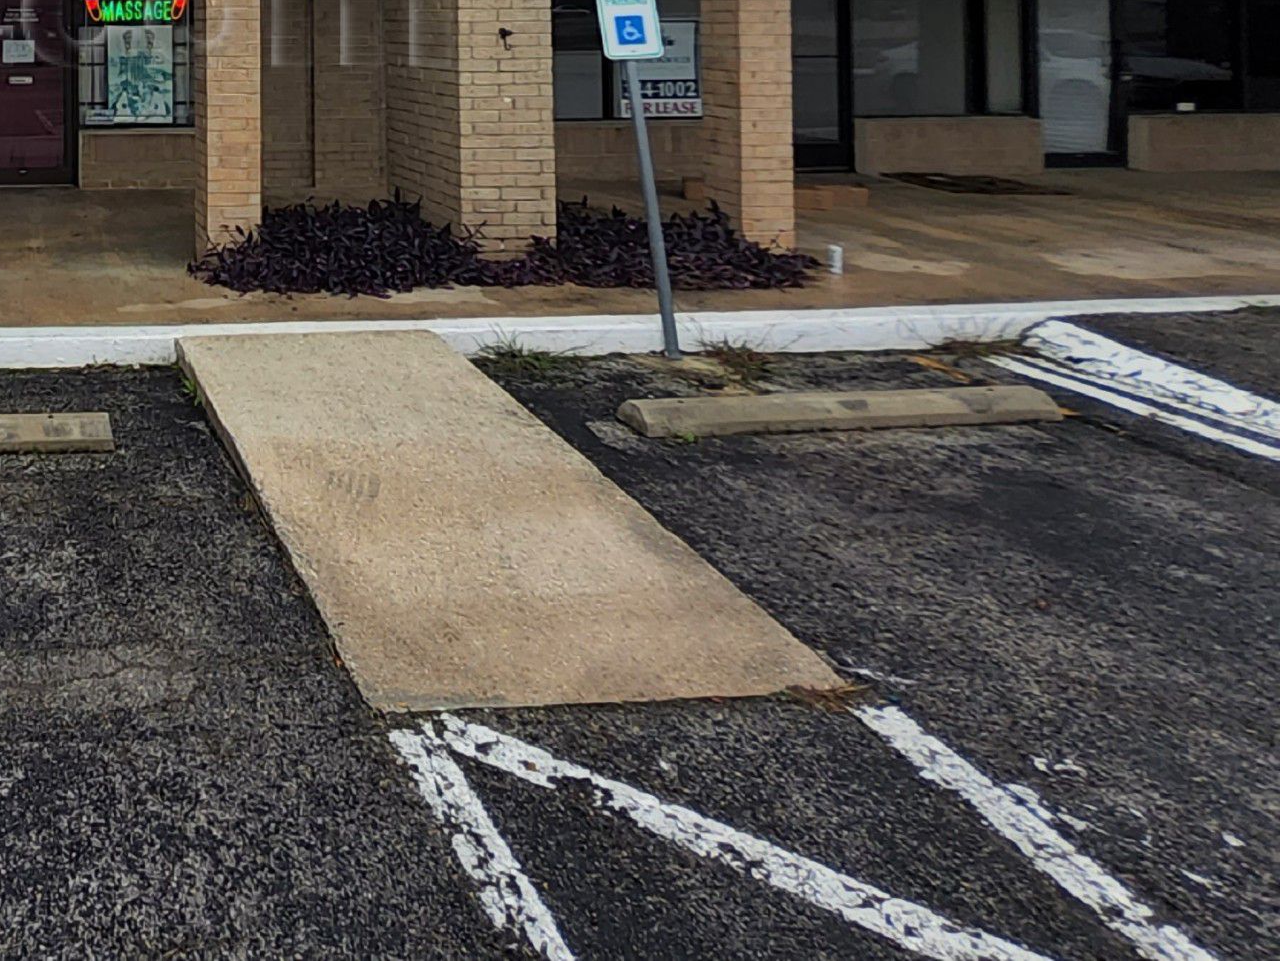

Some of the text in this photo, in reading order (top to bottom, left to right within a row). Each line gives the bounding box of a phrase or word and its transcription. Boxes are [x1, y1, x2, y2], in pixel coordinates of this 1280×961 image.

[100, 0, 172, 22] MASSAGE
[624, 101, 699, 115] FR LEASE
